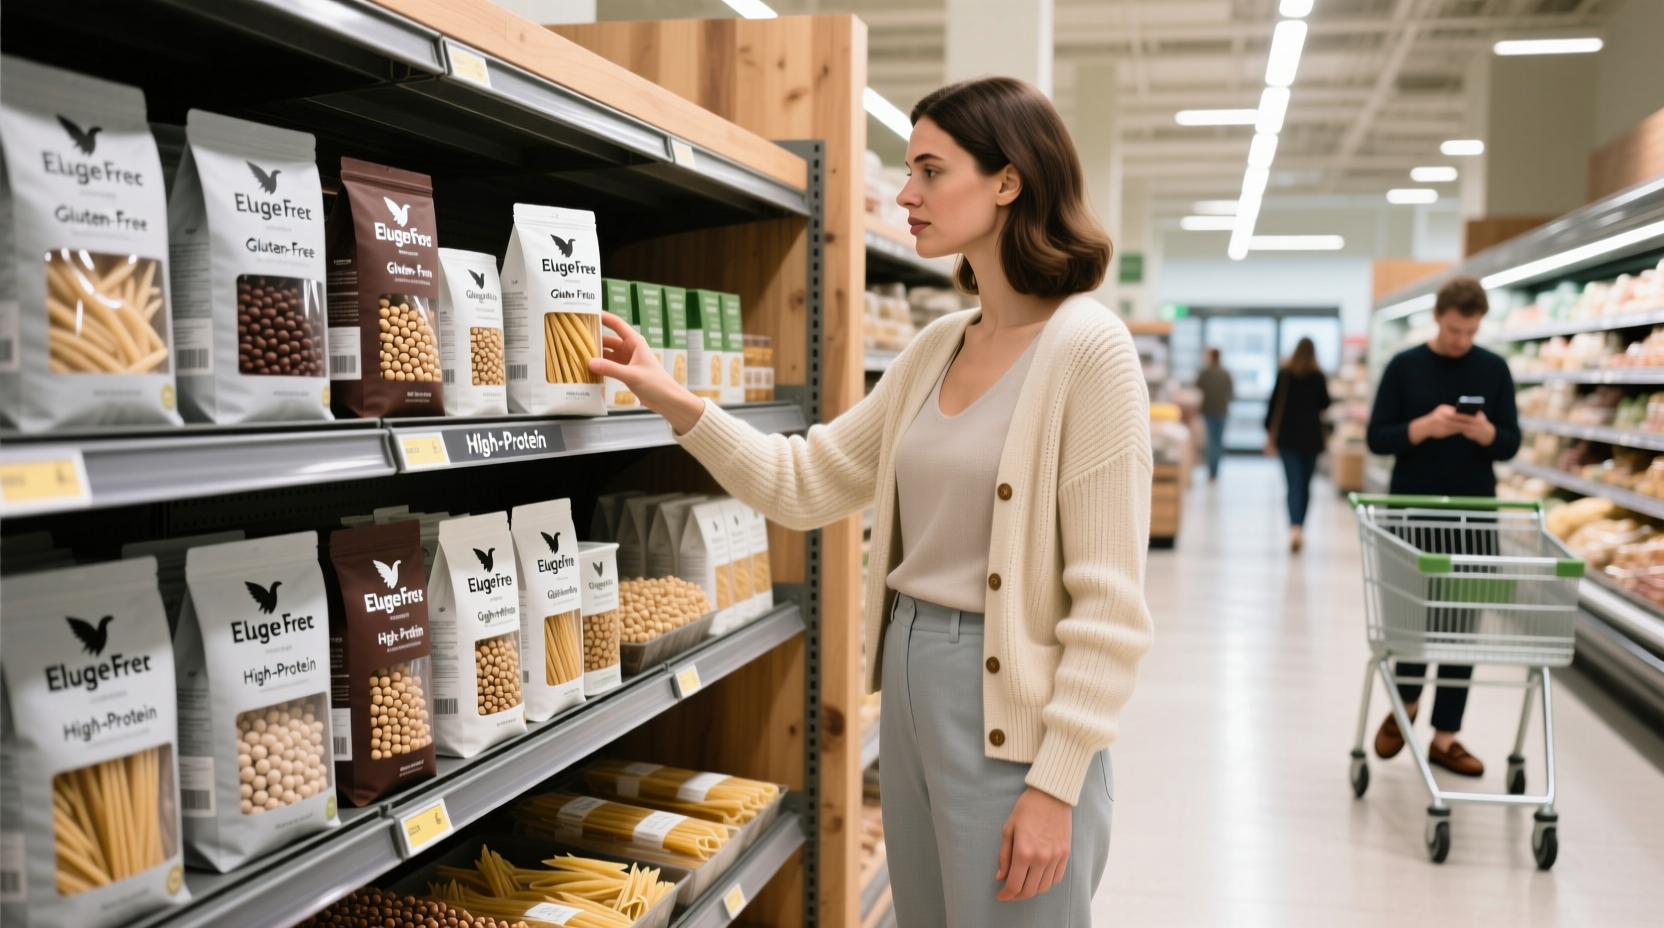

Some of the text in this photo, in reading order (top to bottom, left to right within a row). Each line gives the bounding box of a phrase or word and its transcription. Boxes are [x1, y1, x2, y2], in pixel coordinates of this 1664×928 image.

[466, 430, 547, 457] High-Protein
[243, 656, 316, 687] High-Protein
[63, 704, 157, 742] High-Protein
